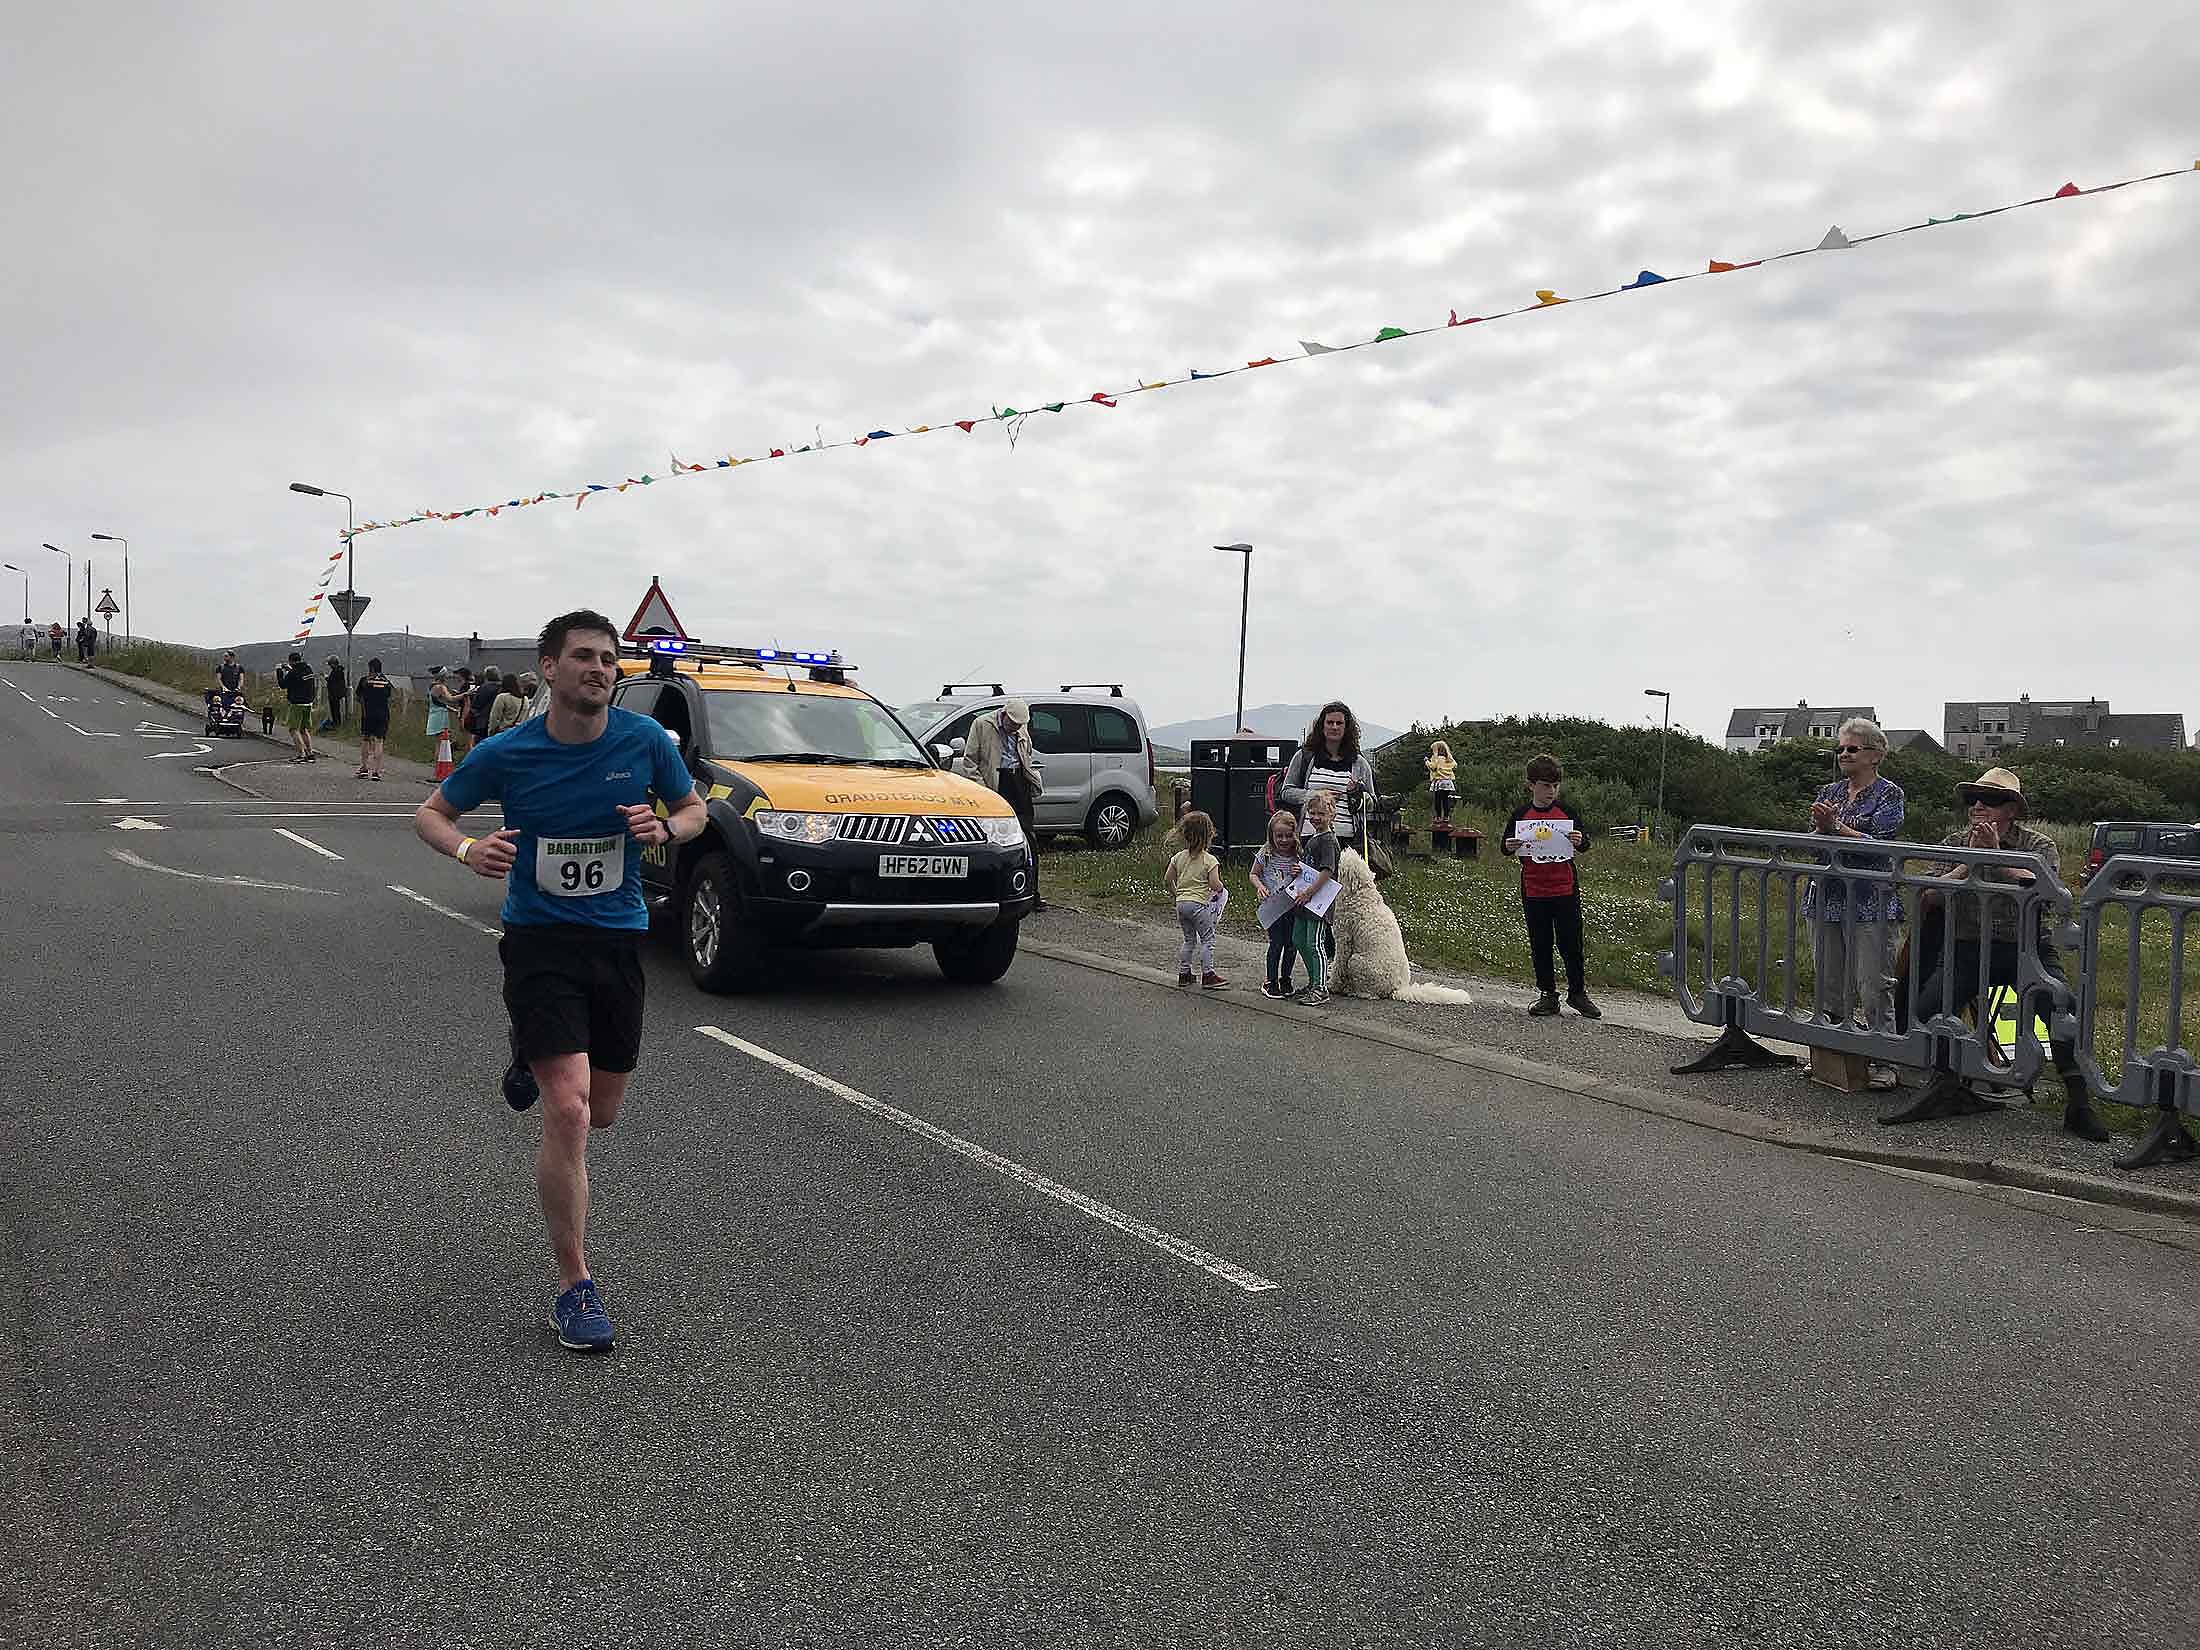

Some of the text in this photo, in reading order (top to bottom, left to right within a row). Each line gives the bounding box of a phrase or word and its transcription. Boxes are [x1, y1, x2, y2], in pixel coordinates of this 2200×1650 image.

[546, 840, 617, 856] BARRATHON
[560, 860, 604, 890] 96
[886, 857, 961, 875] HF62 GVN
